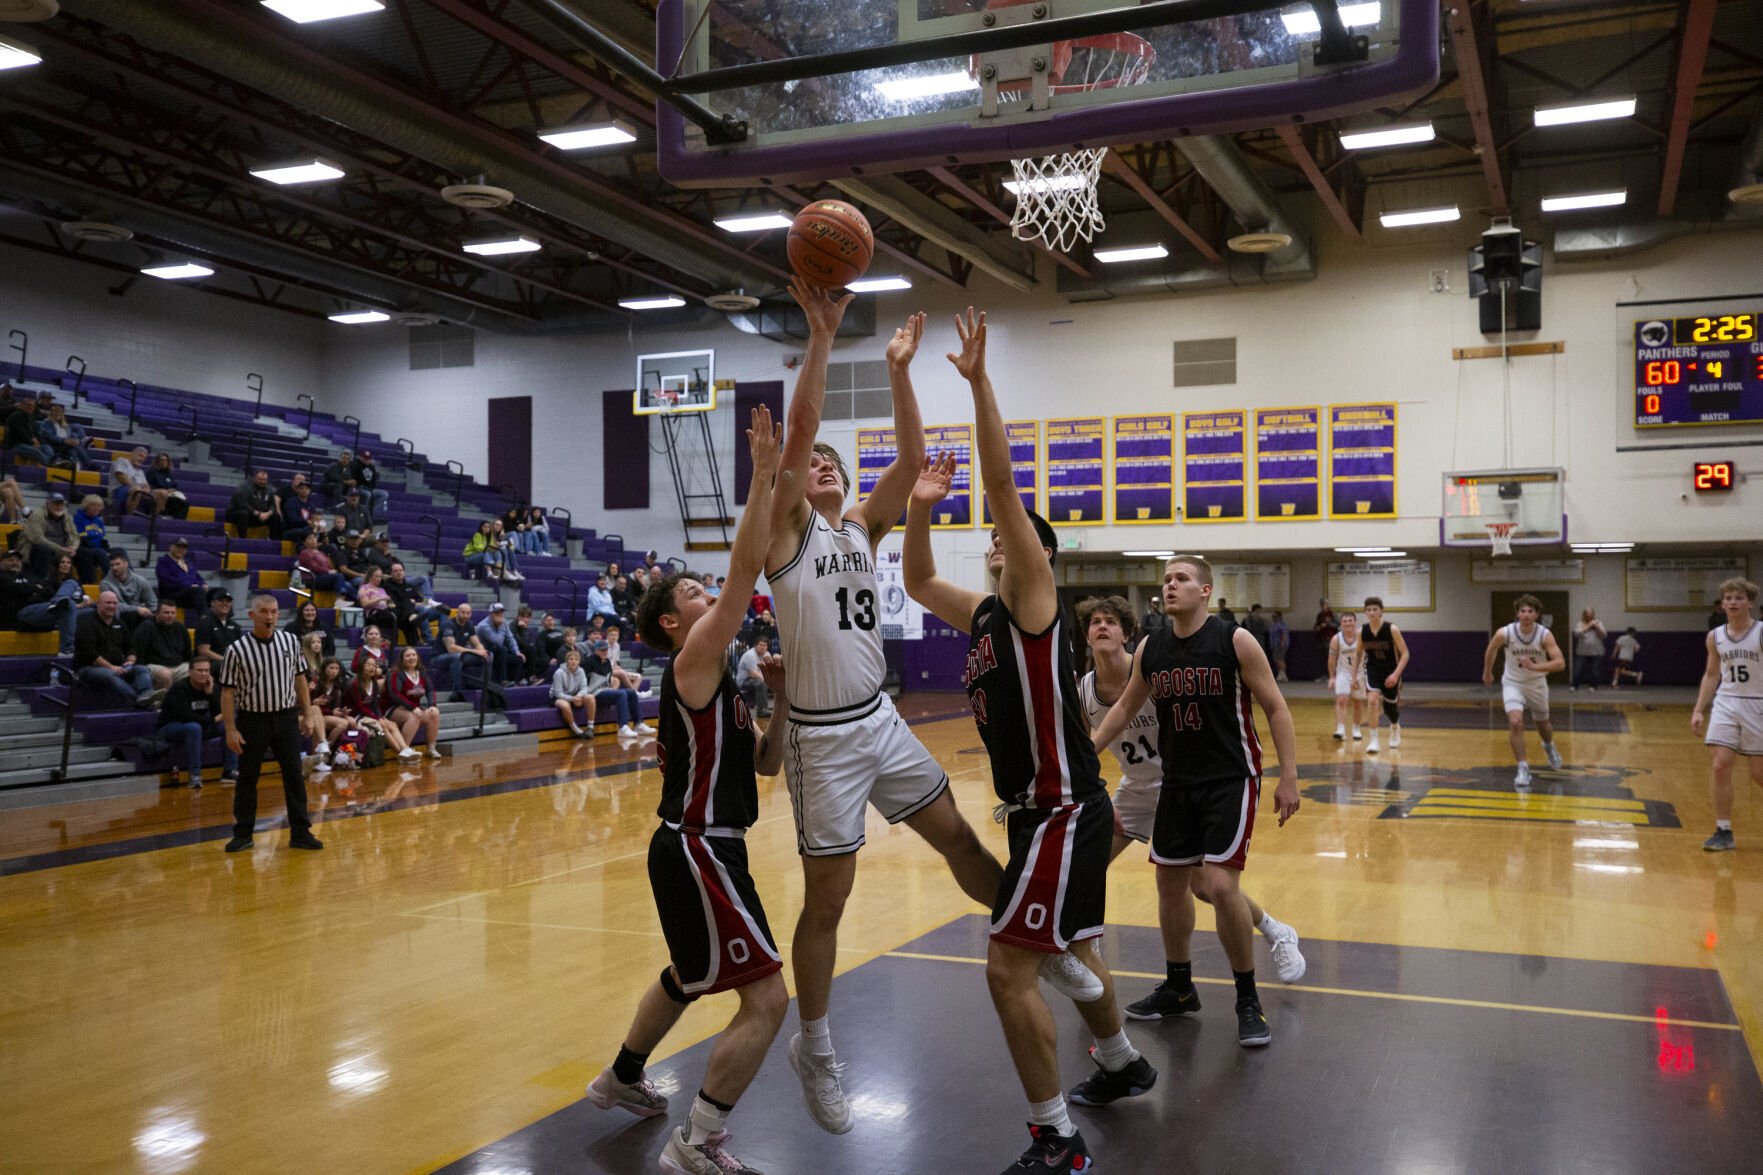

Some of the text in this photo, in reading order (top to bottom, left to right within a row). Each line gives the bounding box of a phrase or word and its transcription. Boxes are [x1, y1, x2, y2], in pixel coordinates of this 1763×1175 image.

[1693, 315, 1753, 342] 2:25
[1638, 346, 1698, 360] PANTHERS
[1701, 350, 1730, 359] PERIOD
[1645, 361, 1680, 385] 60
[1706, 361, 1722, 378] 4
[1637, 386, 1662, 395] FOULS
[1689, 382, 1743, 393] PLAYER FOUL
[1645, 394, 1660, 414] 0
[1637, 416, 1663, 425] SCORE
[1700, 413, 1730, 421] MATCH
[1697, 464, 1730, 488] 29
[835, 586, 877, 632] 13
[1730, 664, 1750, 684] 15
[1172, 702, 1202, 732] 14
[1121, 734, 1158, 766] 21
[1024, 902, 1047, 930] O
[727, 937, 751, 965] O
